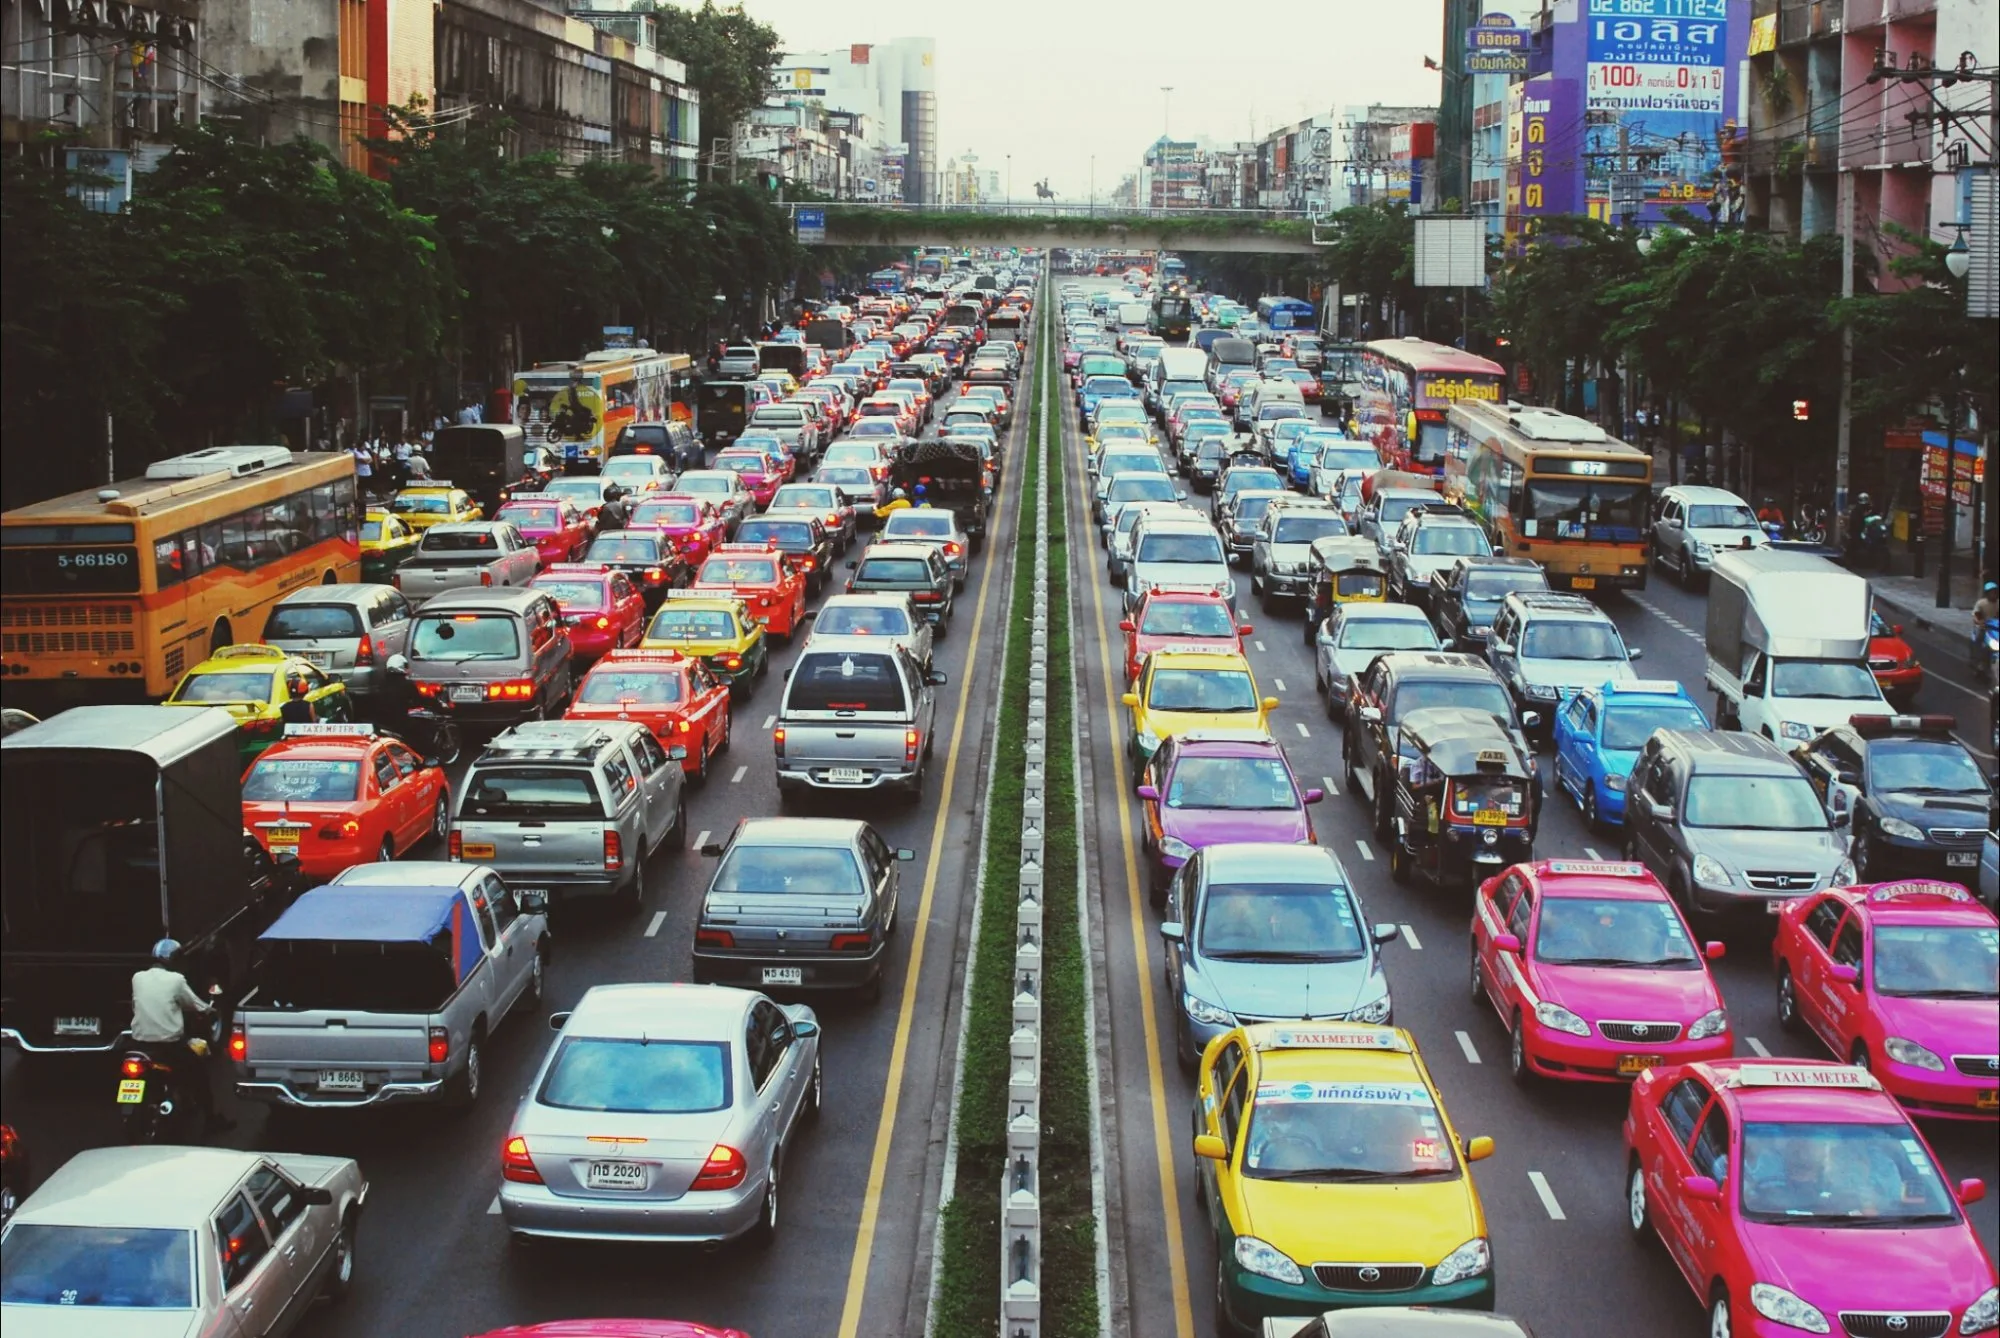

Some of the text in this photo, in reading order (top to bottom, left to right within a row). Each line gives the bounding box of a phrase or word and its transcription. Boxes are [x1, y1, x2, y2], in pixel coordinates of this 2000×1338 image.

[1596, 19, 1719, 45] เอลิส
[1603, 51, 1711, 65] วงเวียนใหญ่
[58, 553, 128, 567] 5-66180
[613, 1165, 641, 1178] 2020
